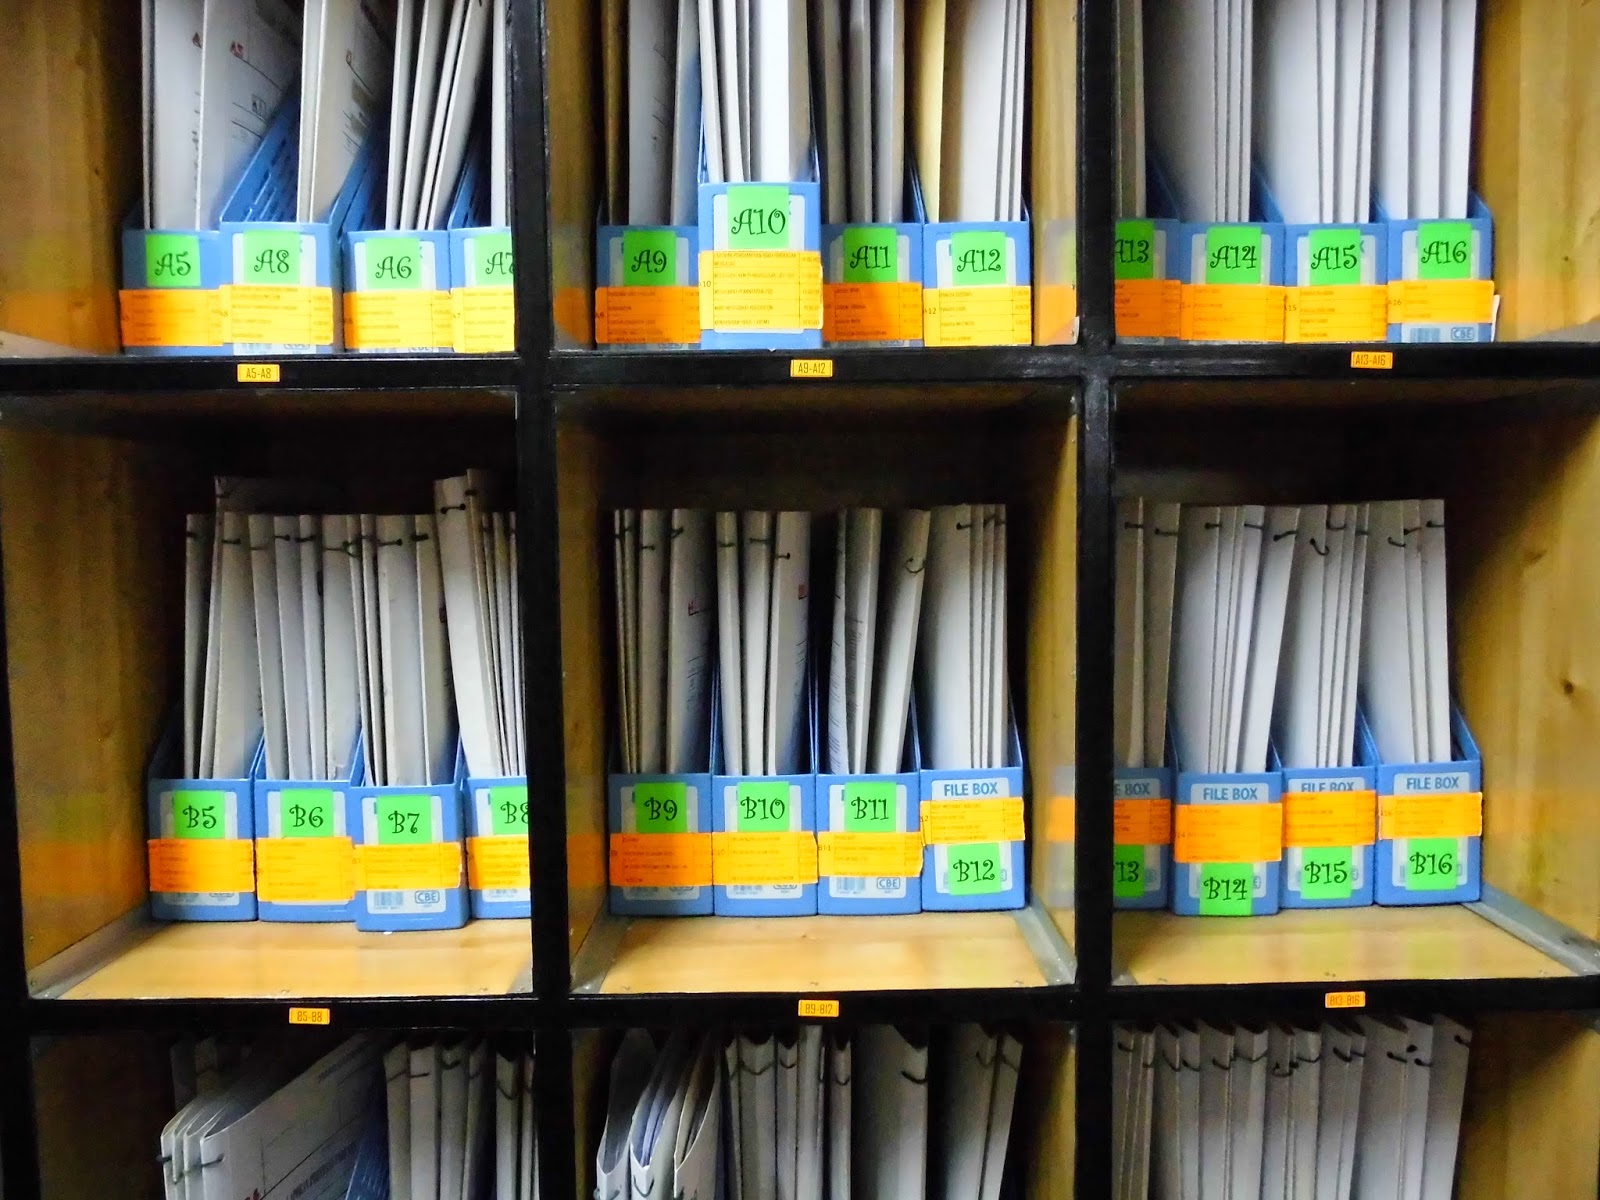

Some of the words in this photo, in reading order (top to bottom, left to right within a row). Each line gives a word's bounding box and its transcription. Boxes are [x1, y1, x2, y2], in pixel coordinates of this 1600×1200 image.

[730, 206, 787, 236] A10
[154, 251, 192, 277] A5
[253, 248, 290, 274] A8
[631, 245, 668, 273] A9
[849, 244, 893, 270] A11
[955, 247, 1003, 273] A12
[1209, 245, 1258, 270] A14
[1310, 244, 1358, 270] A15
[1420, 240, 1468, 265] A16
[375, 256, 412, 279] A6
[1453, 328, 1474, 339] CBE
[797, 361, 827, 375] A9-A12
[1355, 353, 1386, 366] A13-A16
[245, 366, 272, 380] A5-A8
[943, 783, 969, 797] FILE
[973, 781, 998, 795] BOX
[1124, 783, 1150, 796] BOX
[1203, 788, 1229, 801] FILE
[1233, 787, 1258, 800] BOX
[1406, 777, 1431, 791] FILE
[1434, 776, 1459, 789] BOX
[182, 804, 217, 830] B5
[289, 804, 324, 828] B6
[644, 796, 678, 822] B9
[740, 795, 786, 821] B10
[850, 796, 890, 822] B11
[387, 810, 421, 834] B7
[952, 858, 996, 883] B12
[1114, 860, 1140, 883] 13
[1304, 860, 1348, 885] B15
[1409, 851, 1453, 875] B16
[878, 878, 899, 889] CBE
[1203, 876, 1248, 901] B14
[417, 892, 437, 902] CBE
